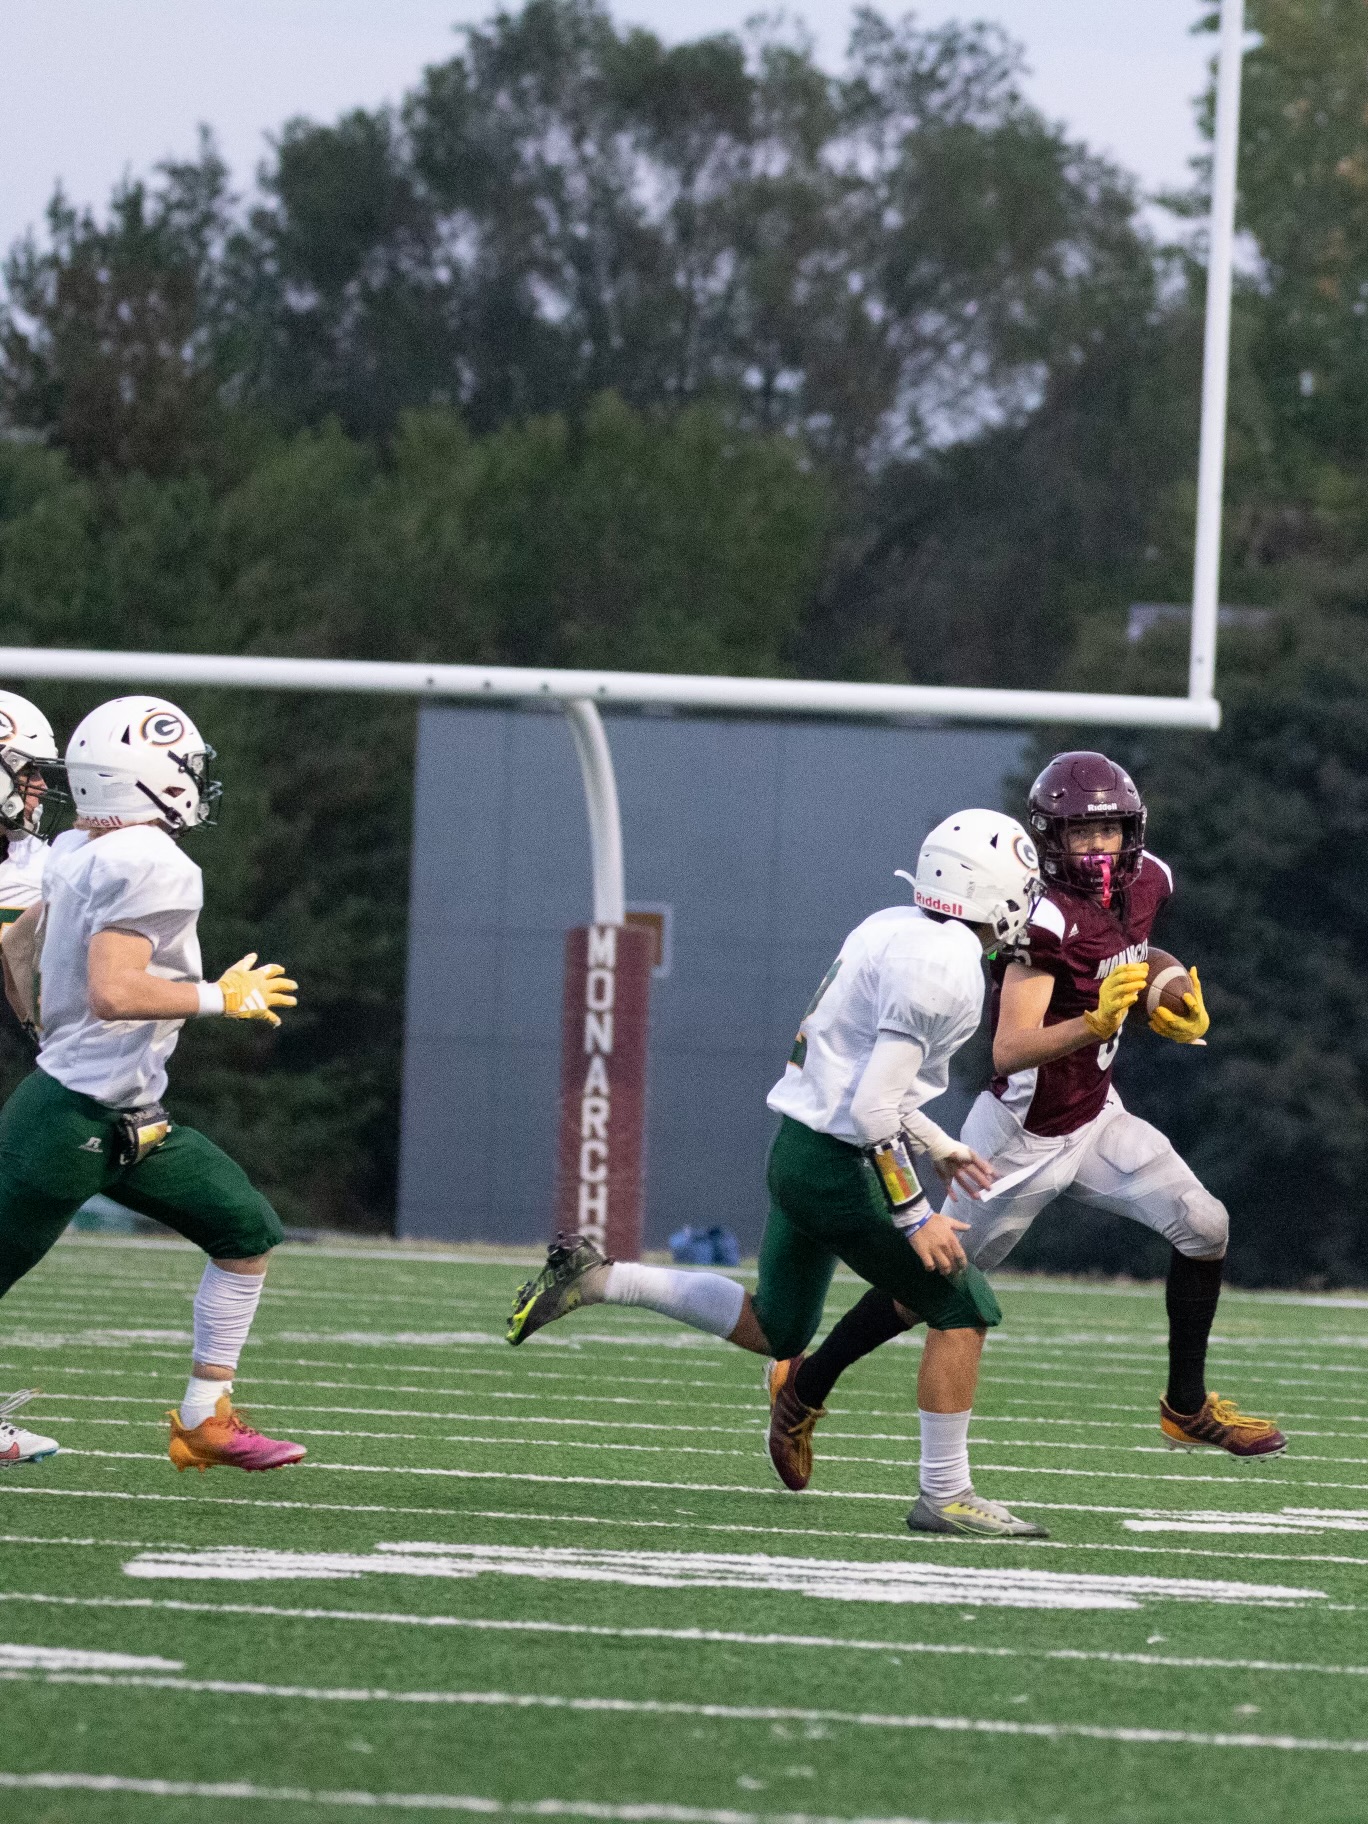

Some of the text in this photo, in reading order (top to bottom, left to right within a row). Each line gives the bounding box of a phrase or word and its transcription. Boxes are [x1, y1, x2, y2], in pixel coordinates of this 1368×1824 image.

[143, 713, 184, 746] G
[1087, 803, 1118, 812] Riddell
[916, 891, 963, 916] Riddell
